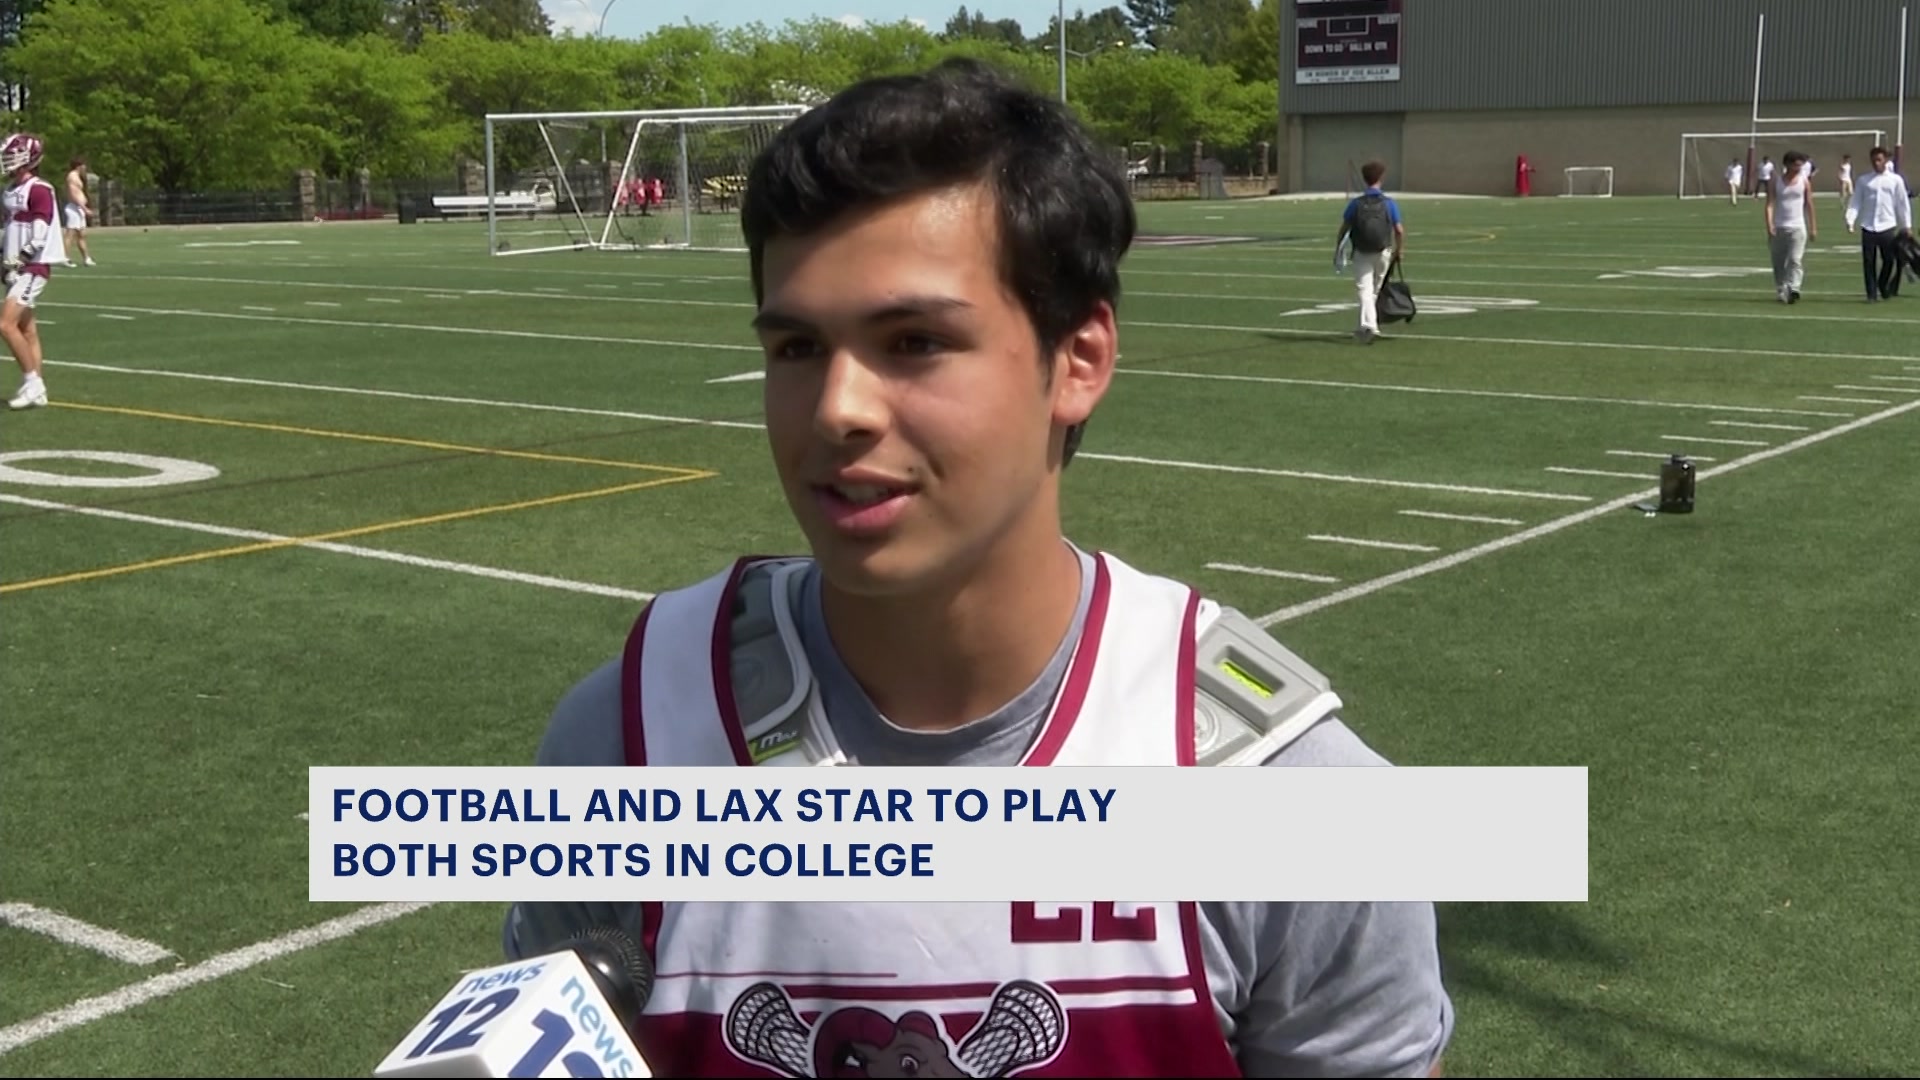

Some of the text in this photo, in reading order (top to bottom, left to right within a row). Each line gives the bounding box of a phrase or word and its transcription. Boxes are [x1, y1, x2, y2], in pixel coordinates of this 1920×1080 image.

[457, 962, 547, 996] news
[404, 987, 520, 1060] 12
[507, 1008, 604, 1078] 1
[560, 976, 634, 1079] news
